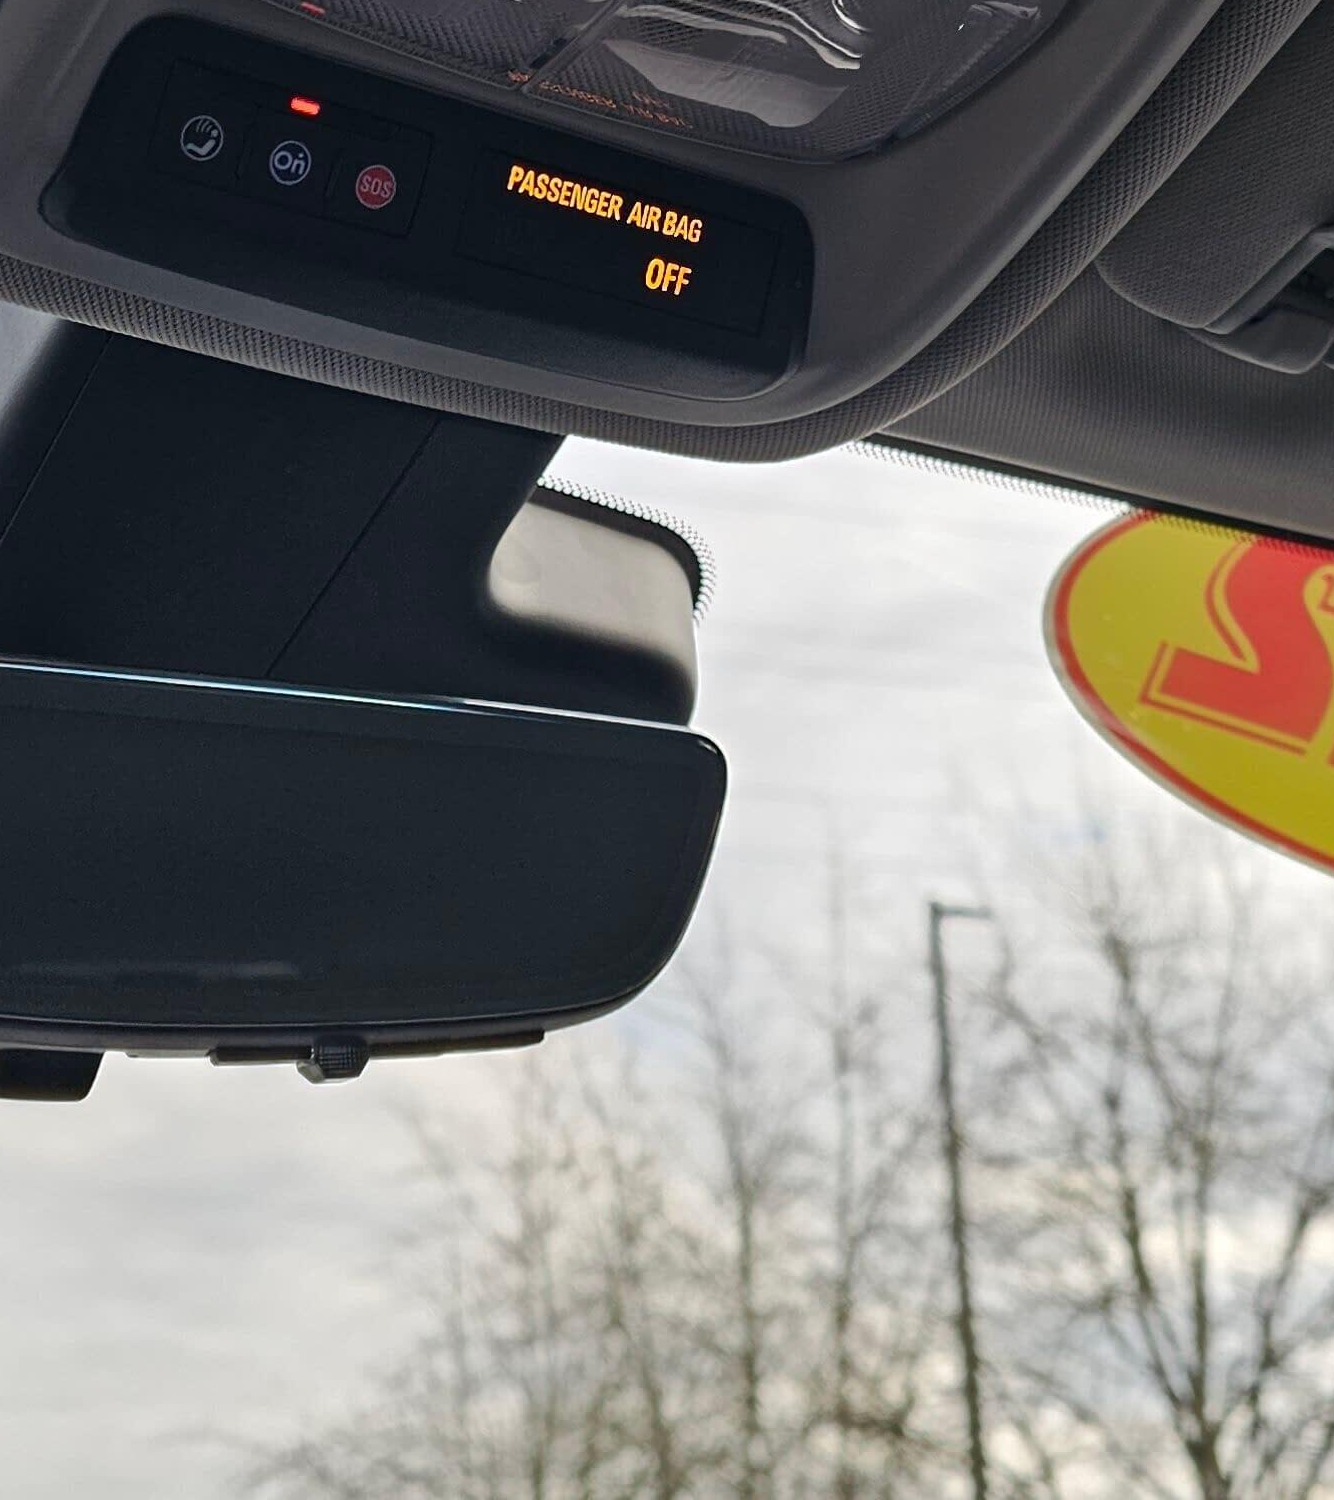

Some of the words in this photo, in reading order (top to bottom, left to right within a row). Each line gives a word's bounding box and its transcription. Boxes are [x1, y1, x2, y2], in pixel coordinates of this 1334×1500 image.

[360, 175, 392, 198] SOS
[507, 165, 623, 221] PASSENGER
[626, 201, 662, 232] AIR
[662, 211, 703, 243] BAG
[645, 257, 692, 296] OFF
